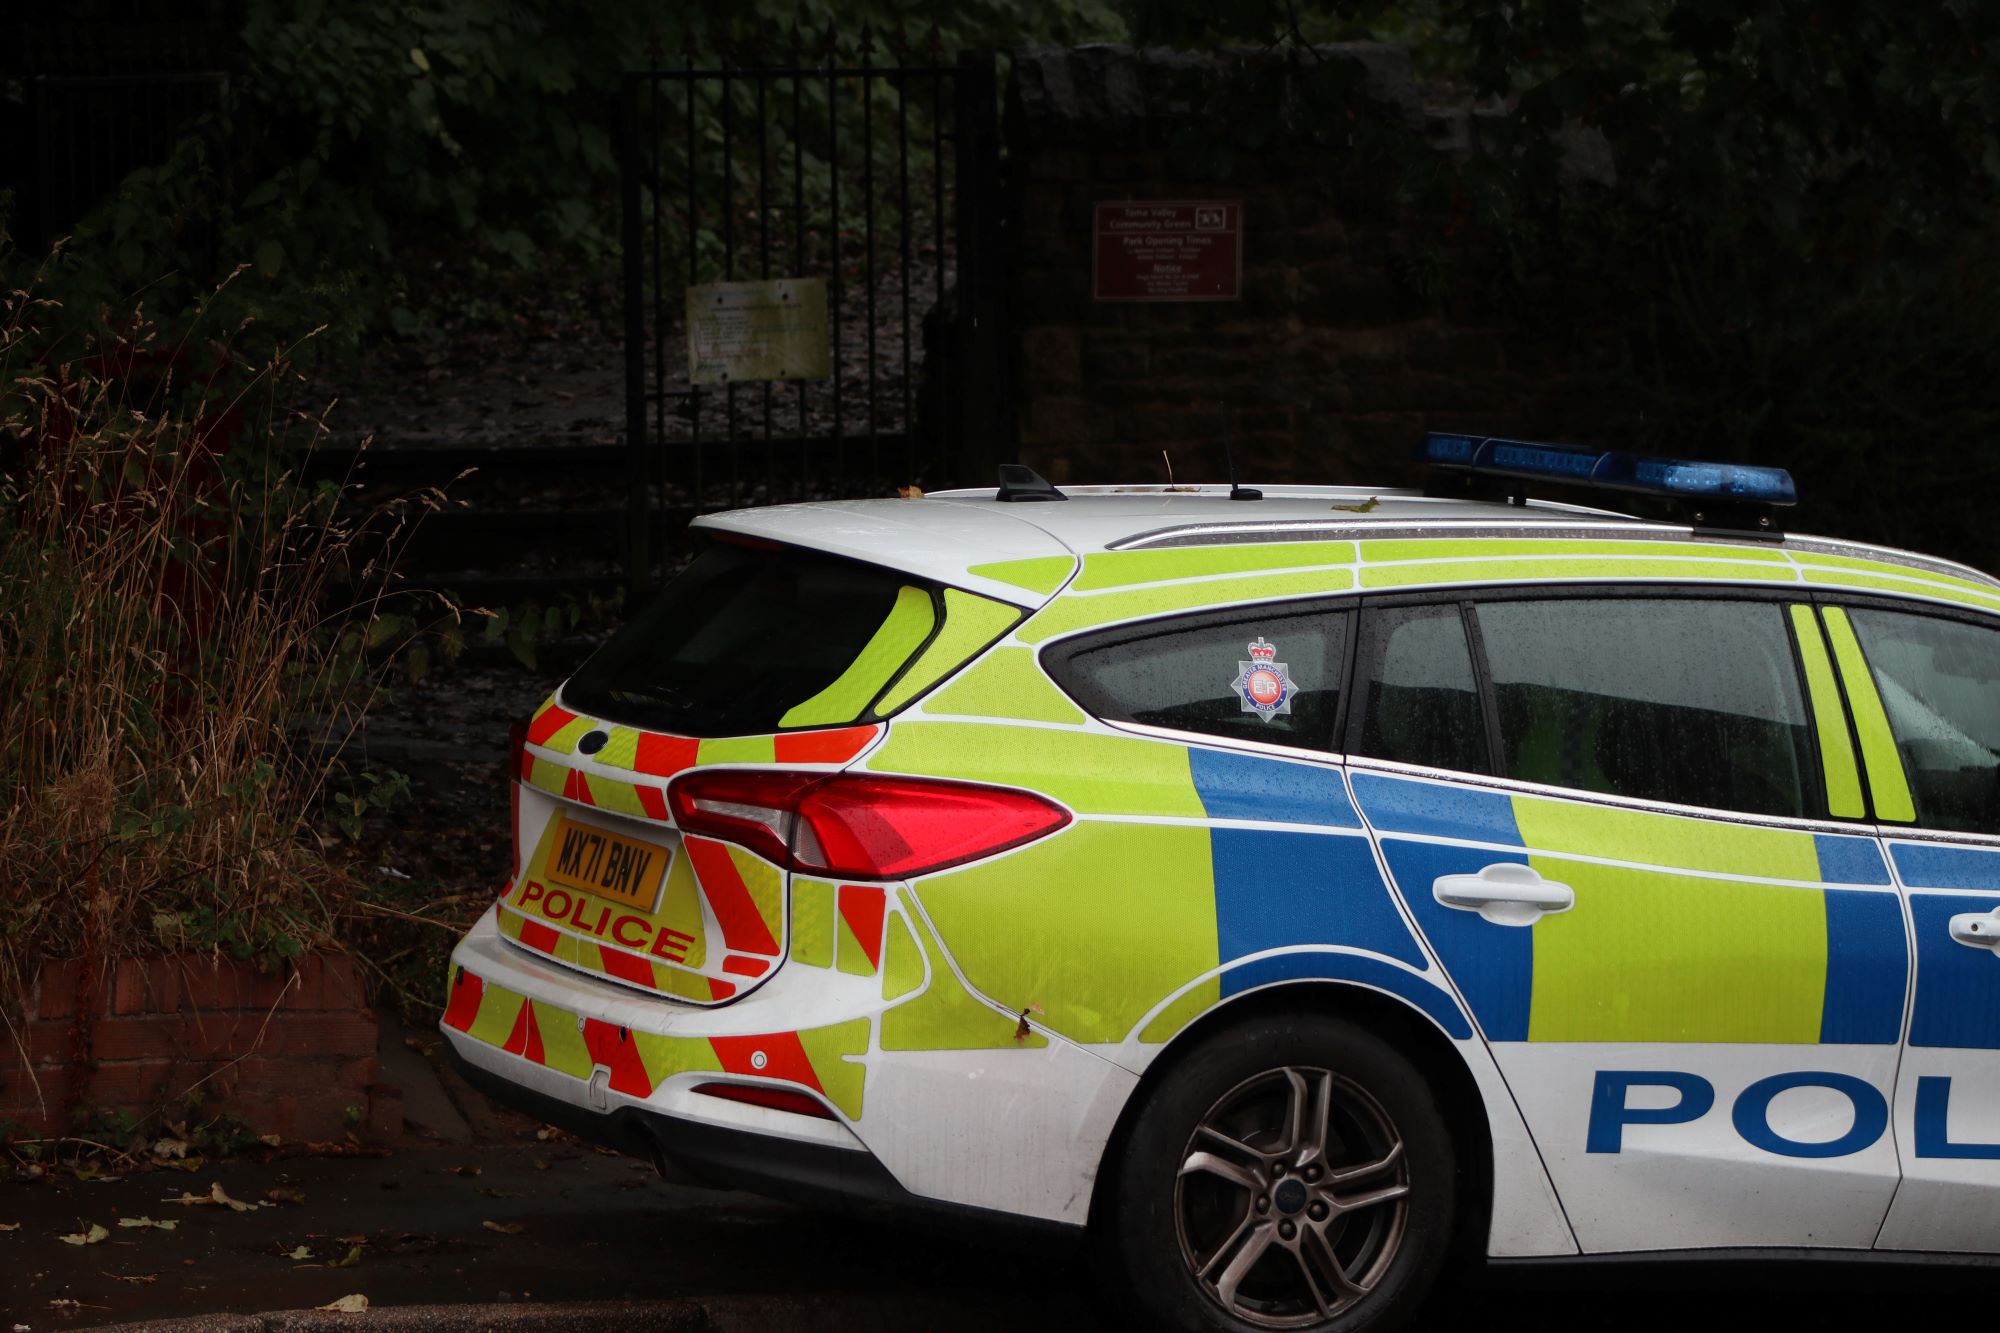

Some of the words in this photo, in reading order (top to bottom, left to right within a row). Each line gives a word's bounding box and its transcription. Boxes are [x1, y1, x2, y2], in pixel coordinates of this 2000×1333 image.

[1151, 208, 1177, 218] Valley
[1110, 220, 1161, 230] Community
[1164, 219, 1191, 229] Green
[1123, 236, 1143, 245] Park
[1145, 236, 1183, 247] Opening
[1186, 235, 1212, 245] Times
[1257, 665, 1287, 691] MANCHESTER
[1255, 703, 1275, 711] POLICE
[557, 827, 607, 884] MX71
[601, 842, 652, 897] BNV
[517, 880, 696, 964] POLICE
